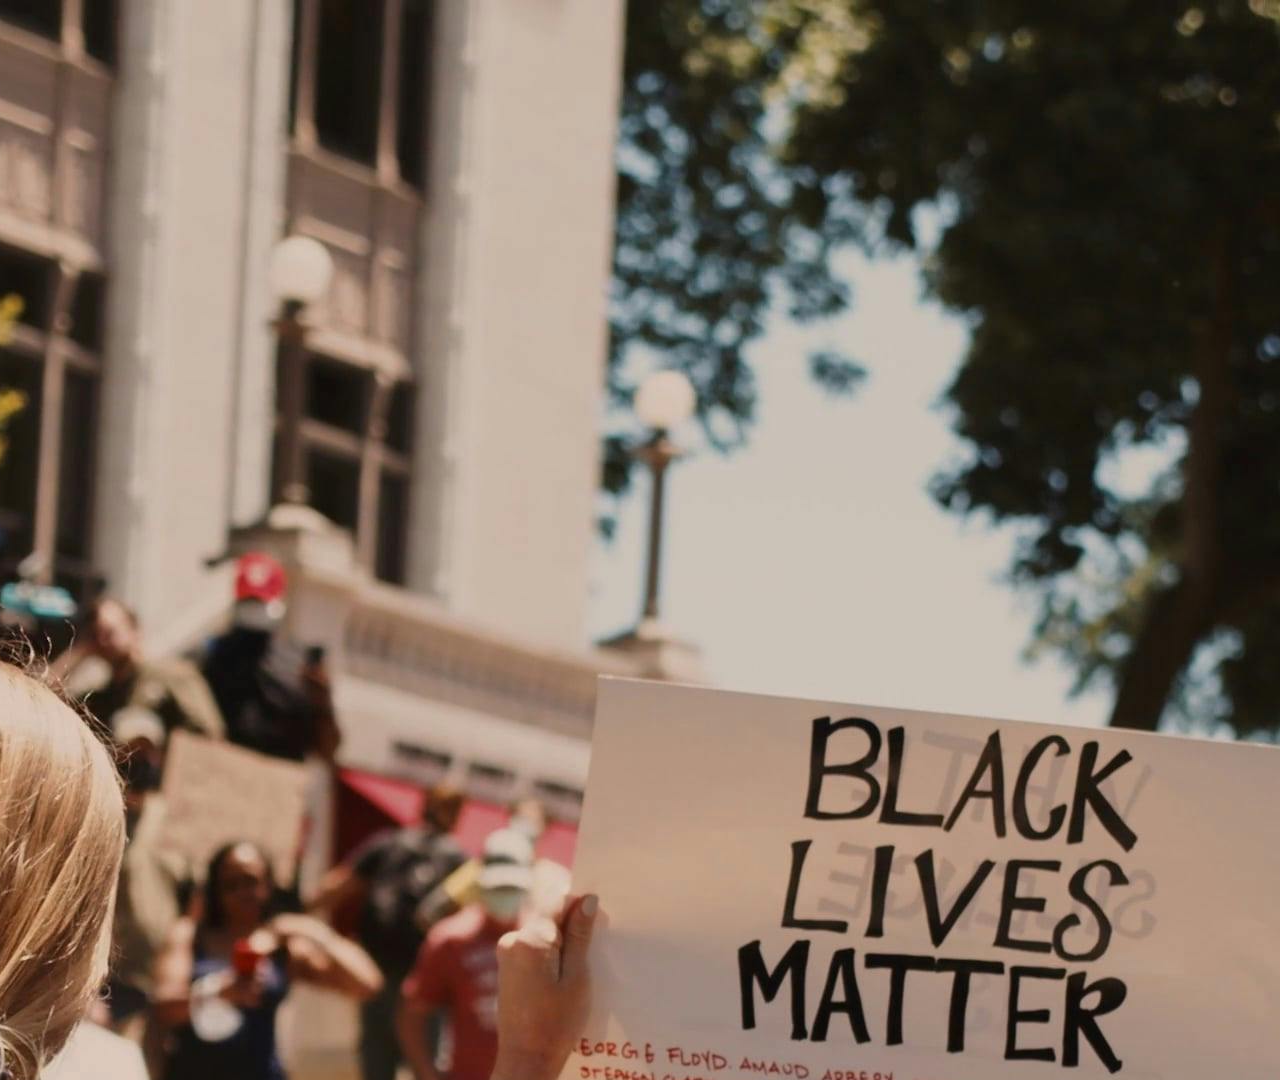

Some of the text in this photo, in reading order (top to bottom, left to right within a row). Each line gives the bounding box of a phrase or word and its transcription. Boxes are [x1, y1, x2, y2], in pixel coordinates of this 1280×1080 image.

[803, 716, 1138, 852] BLACK
[781, 839, 1129, 962] LIVES
[573, 1038, 654, 1063] EORGE
[666, 1047, 732, 1071] FLOYD.
[739, 1057, 809, 1080] AMAUD
[738, 940, 1127, 1074] MATTER
